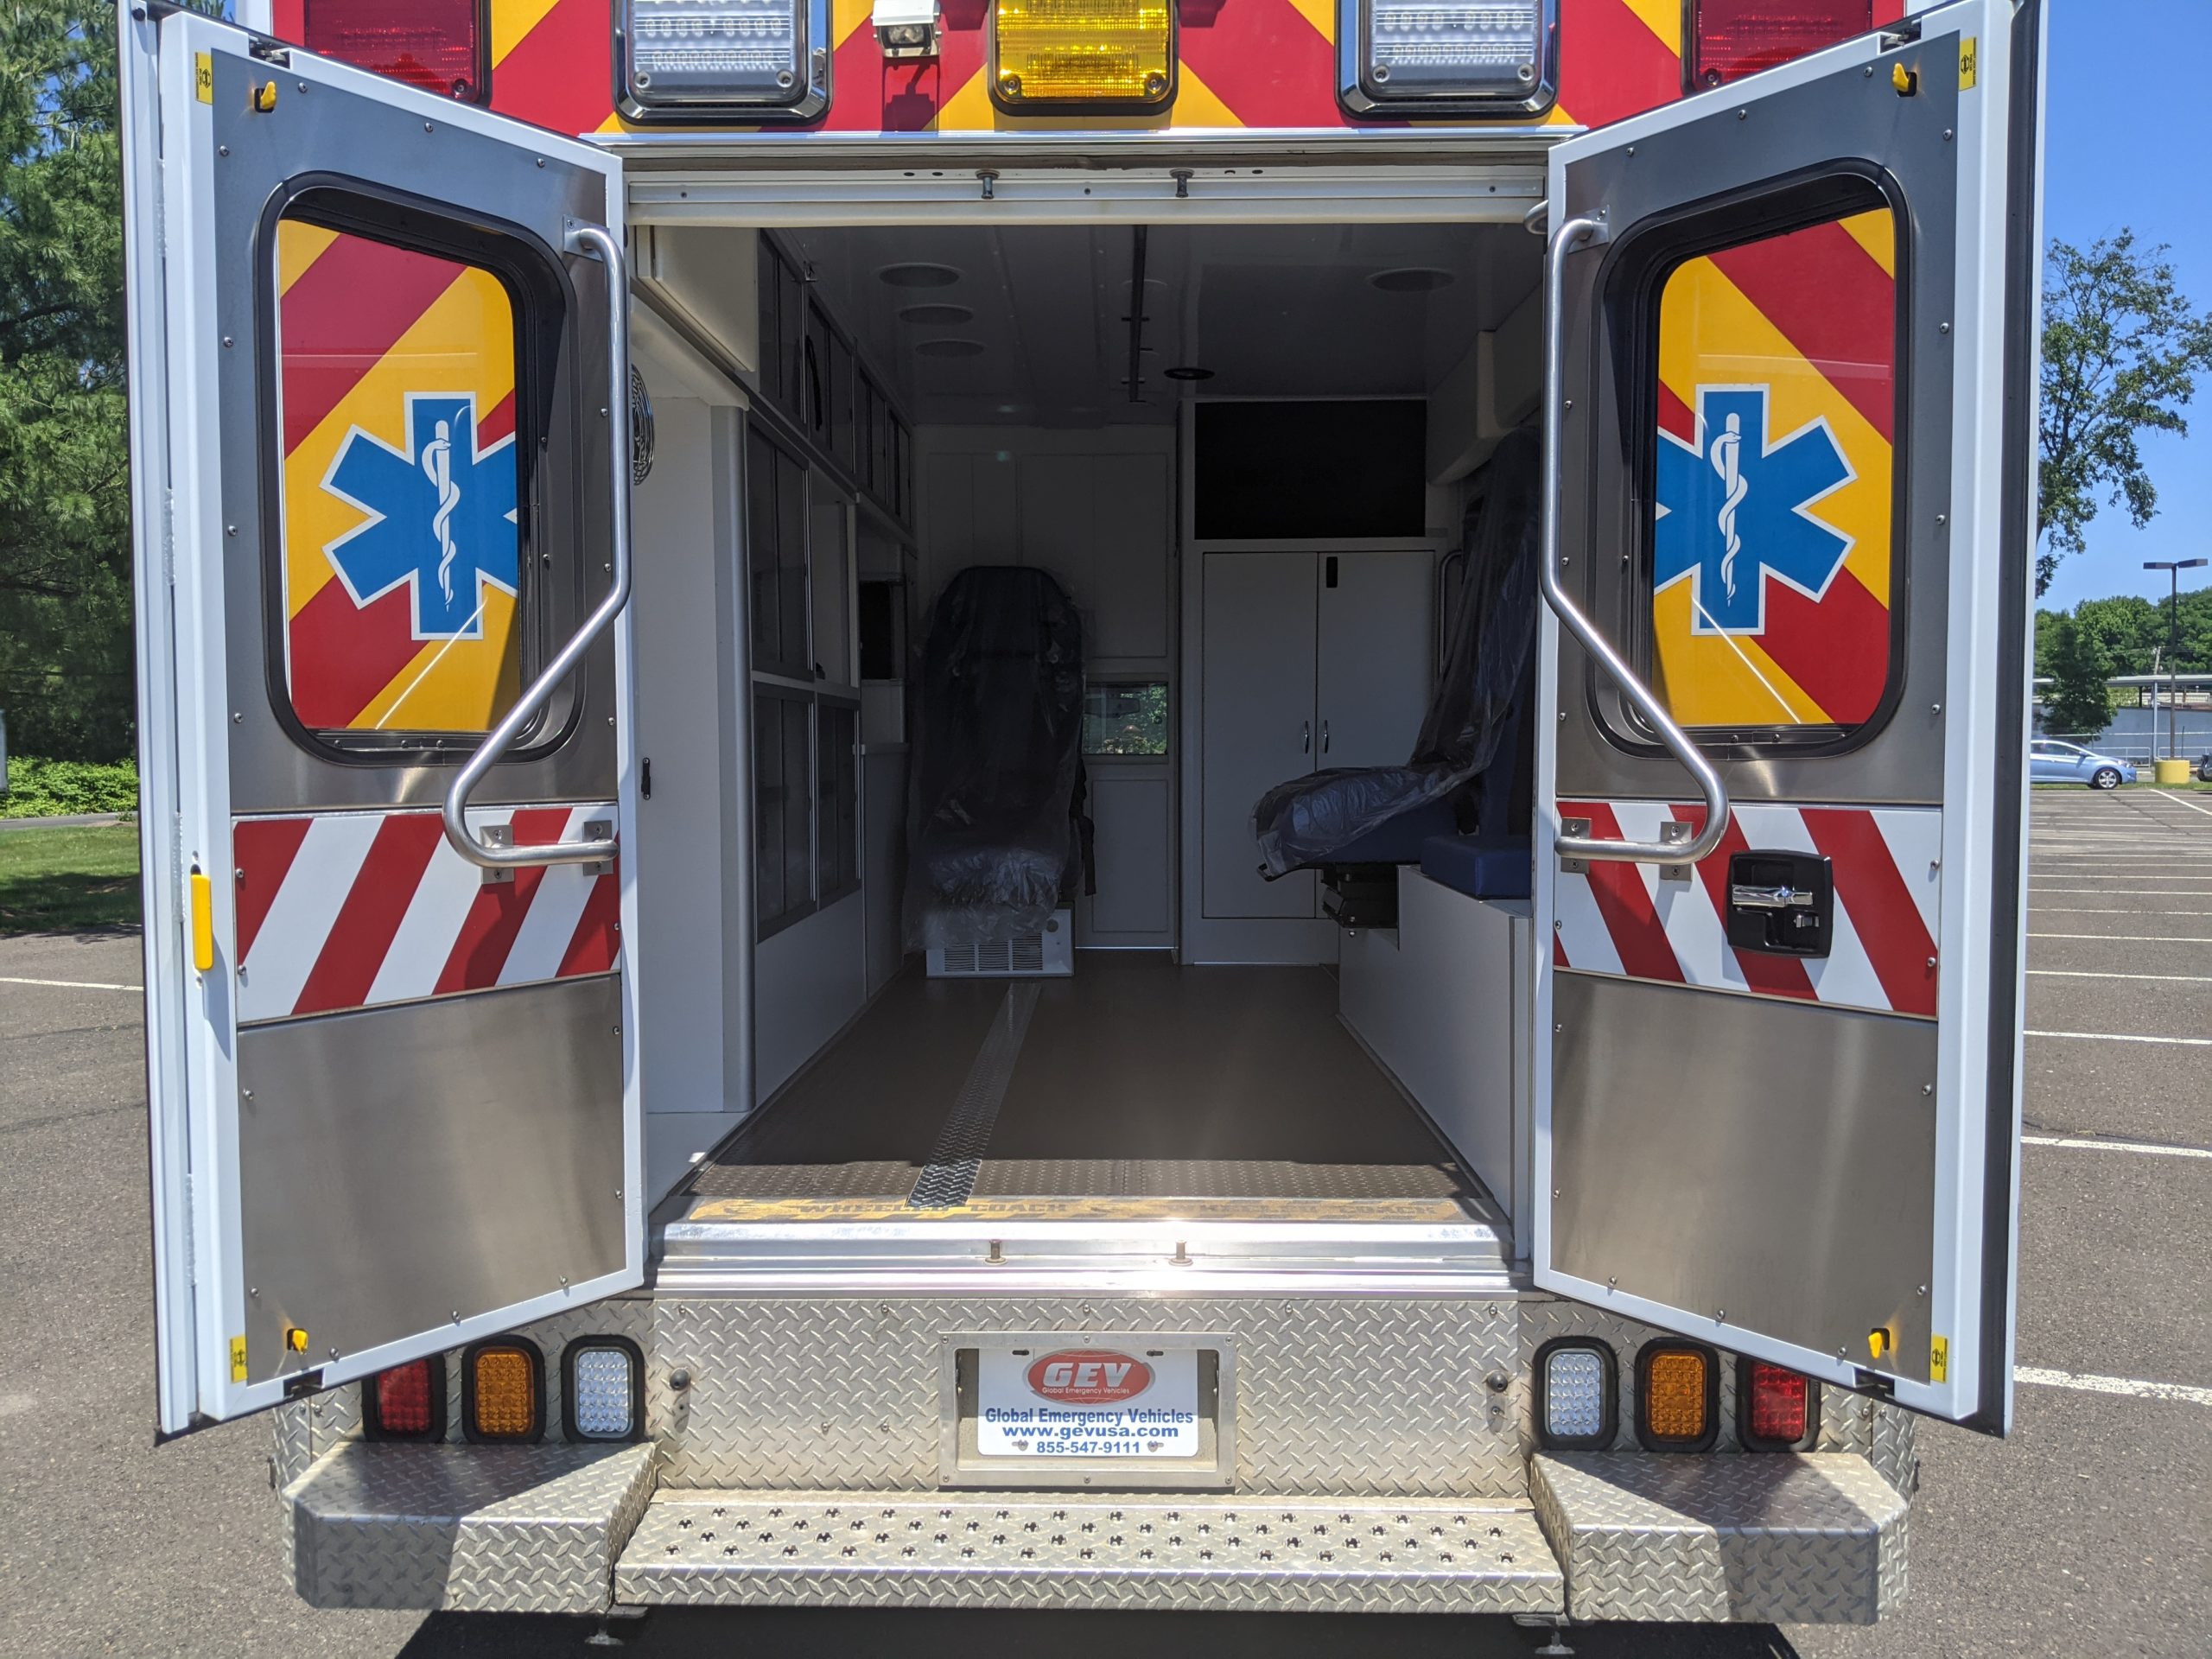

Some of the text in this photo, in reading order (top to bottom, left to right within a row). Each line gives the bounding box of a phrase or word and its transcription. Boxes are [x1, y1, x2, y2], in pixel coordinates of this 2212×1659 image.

[969, 1204, 1068, 1212] COACH
[1042, 1363, 1132, 1387] GEV
[1065, 1387, 1101, 1395] Emergency
[985, 1408, 1194, 1427] Global Emergency Vehicles
[1002, 1426, 1179, 1440] www.gevusa.com
[1037, 1441, 1140, 1453] 855-547-9111
